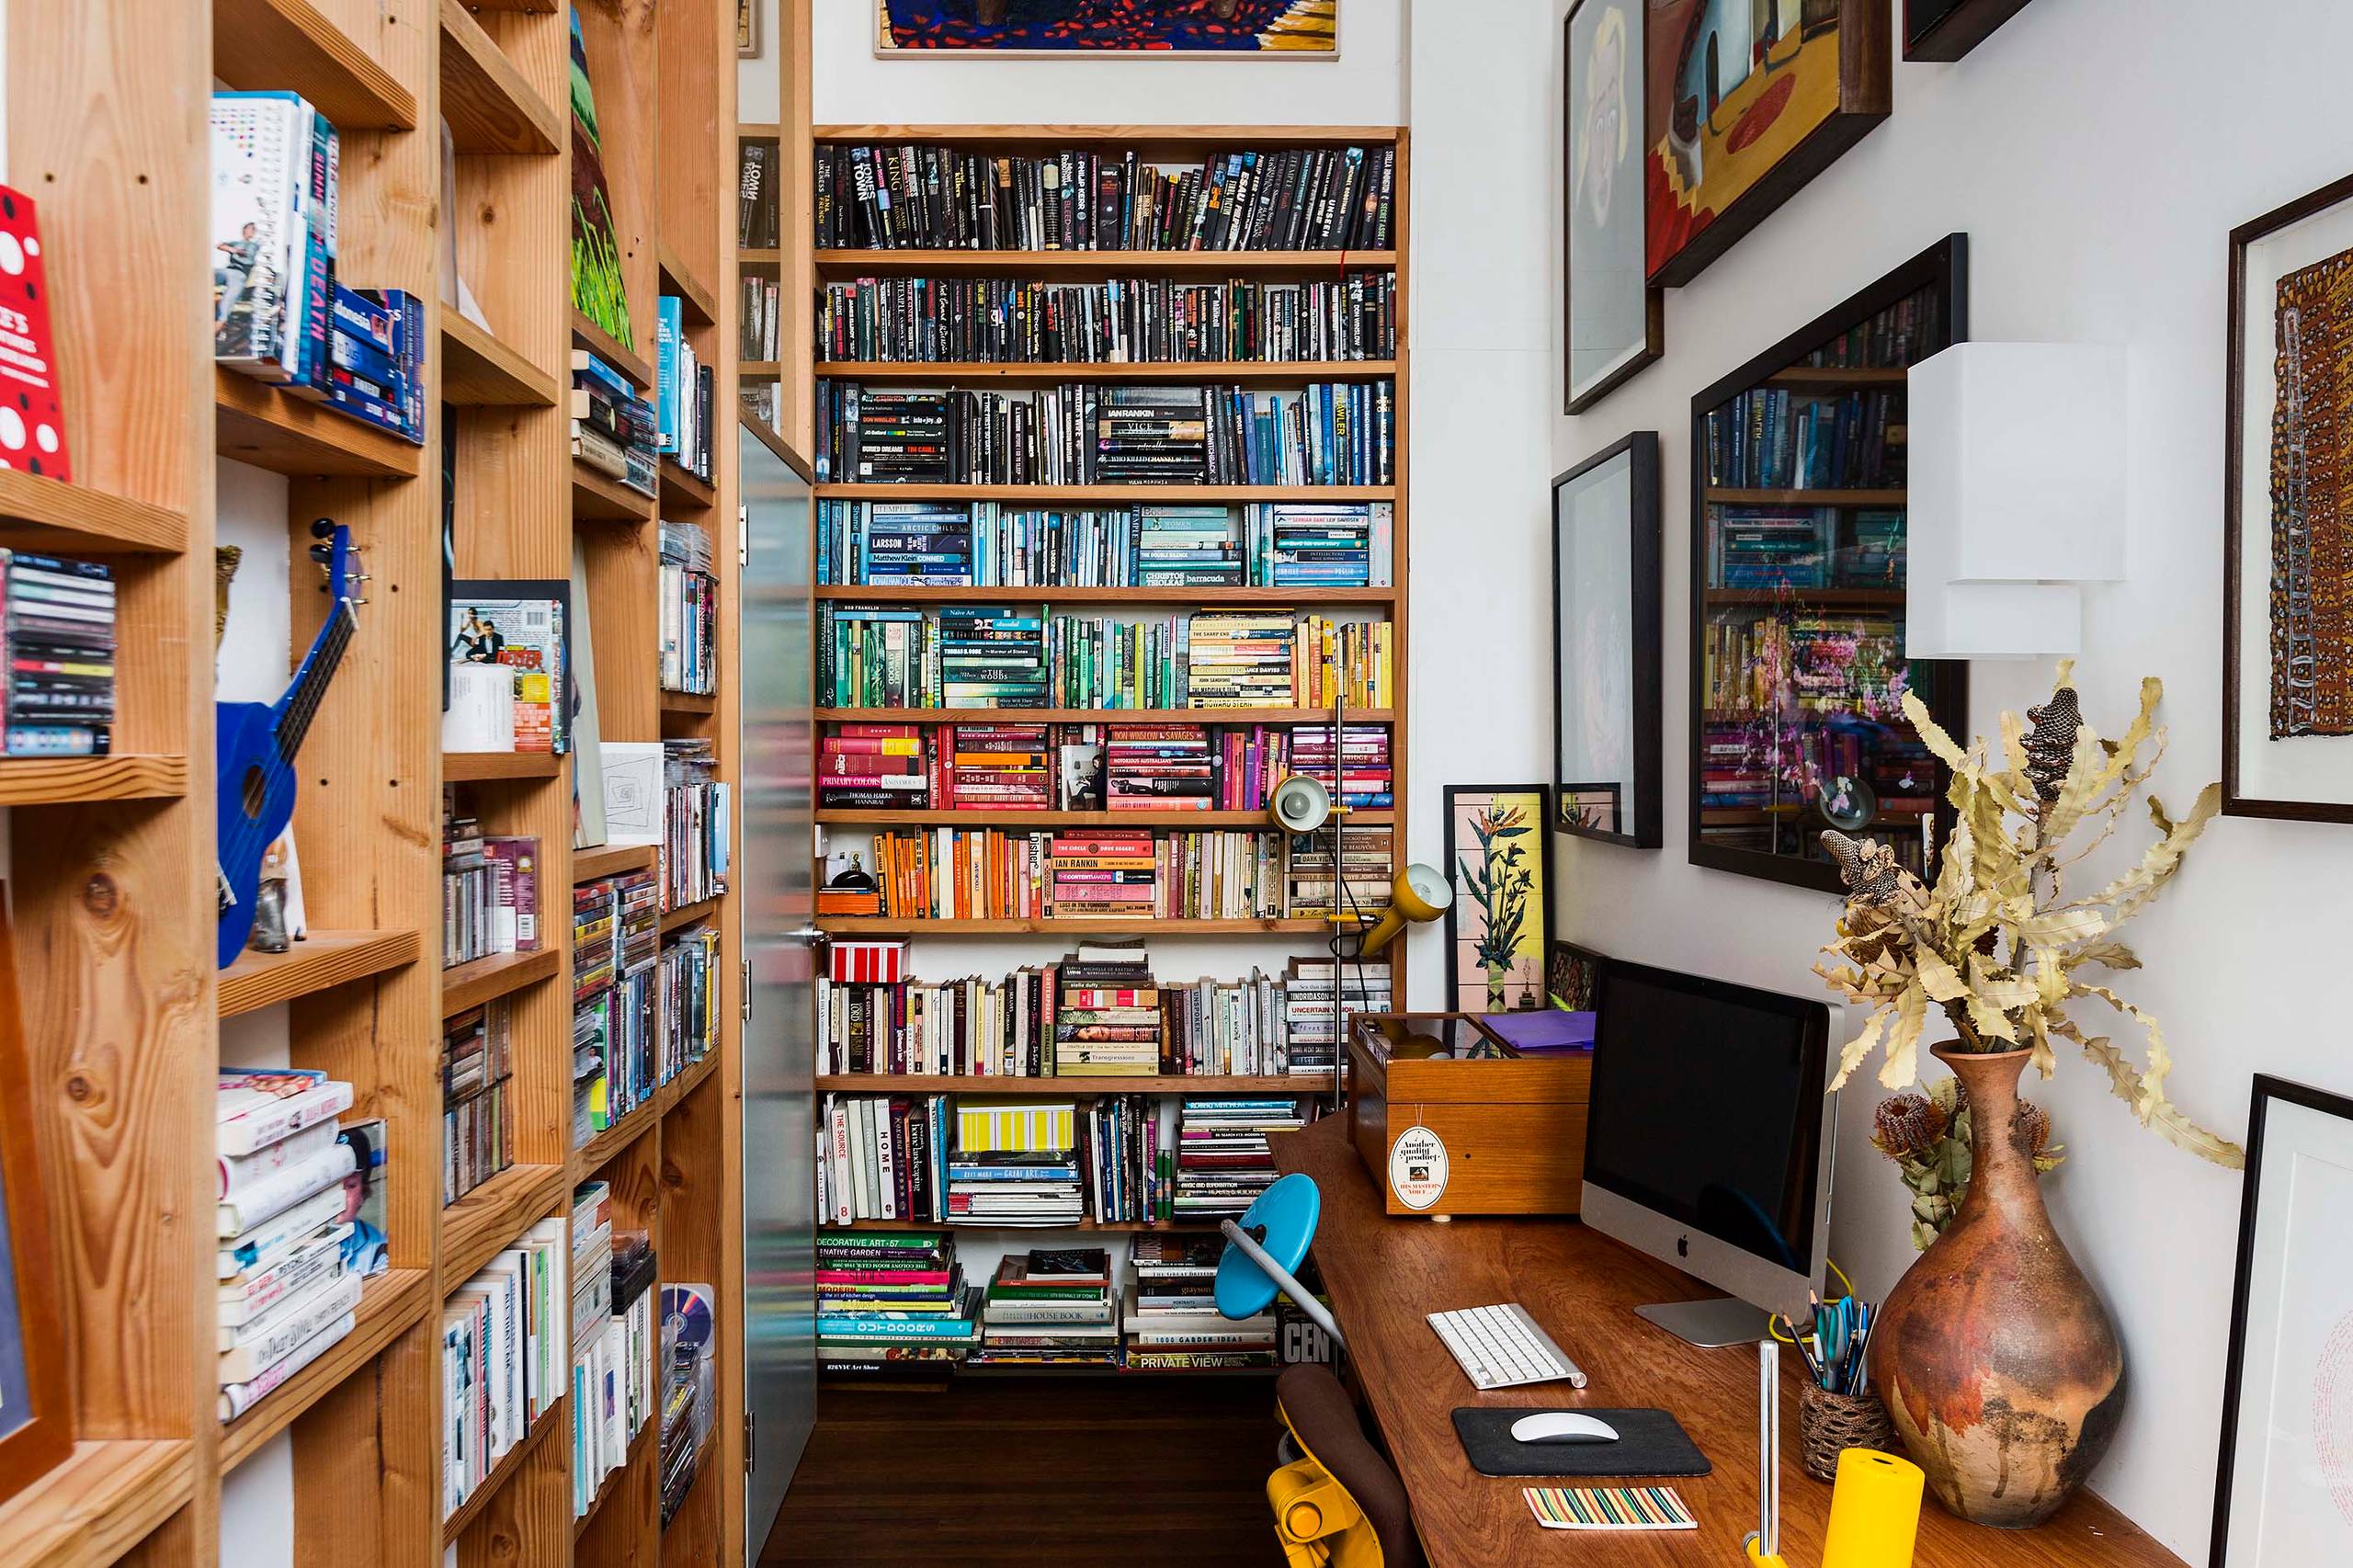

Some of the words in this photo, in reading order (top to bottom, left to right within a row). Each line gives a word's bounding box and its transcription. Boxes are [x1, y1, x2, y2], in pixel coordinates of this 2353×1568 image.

[1256, 155, 1264, 175] PHILIP
[1384, 151, 1393, 167] STELLA
[854, 163, 867, 201] TOWN
[864, 163, 875, 199] JONES
[888, 157, 902, 191] KING
[1237, 171, 1250, 202] ESAU
[1251, 176, 1260, 192] KERR
[1322, 199, 1336, 237] UNSEEN
[1379, 203, 1388, 223] SECRET
[1378, 224, 1386, 240] ASSET
[311, 256, 326, 341] DEATH
[1207, 433, 1215, 474] SWITCHBACK
[872, 539, 902, 548] LARSSON
[1115, 732, 1127, 740] DON
[1129, 732, 1158, 740] WINSLOW
[1167, 732, 1194, 740] SAVAGES
[823, 777, 851, 786] PRIMARY
[853, 777, 881, 786] COLORS
[1029, 836, 1039, 865] Disher
[851, 1003, 859, 1021] LORD
[1111, 1028, 1134, 1040] HOWARD
[1136, 1028, 1153, 1040] STERN
[865, 1128, 874, 1144] New
[911, 1124, 920, 1146] home
[1404, 1140, 1436, 1148] Another
[838, 1130, 846, 1159] SOURCE
[881, 1132, 890, 1173] HOME
[1400, 1147, 1430, 1156] quality
[1405, 1154, 1437, 1163] product
[912, 1148, 923, 1191] landscaping
[817, 1238, 866, 1246] DECORATIVE
[850, 1271, 885, 1281] SHOES
[1141, 1358, 1190, 1368] PRIVATE
[1191, 1357, 1223, 1367] VIEW
